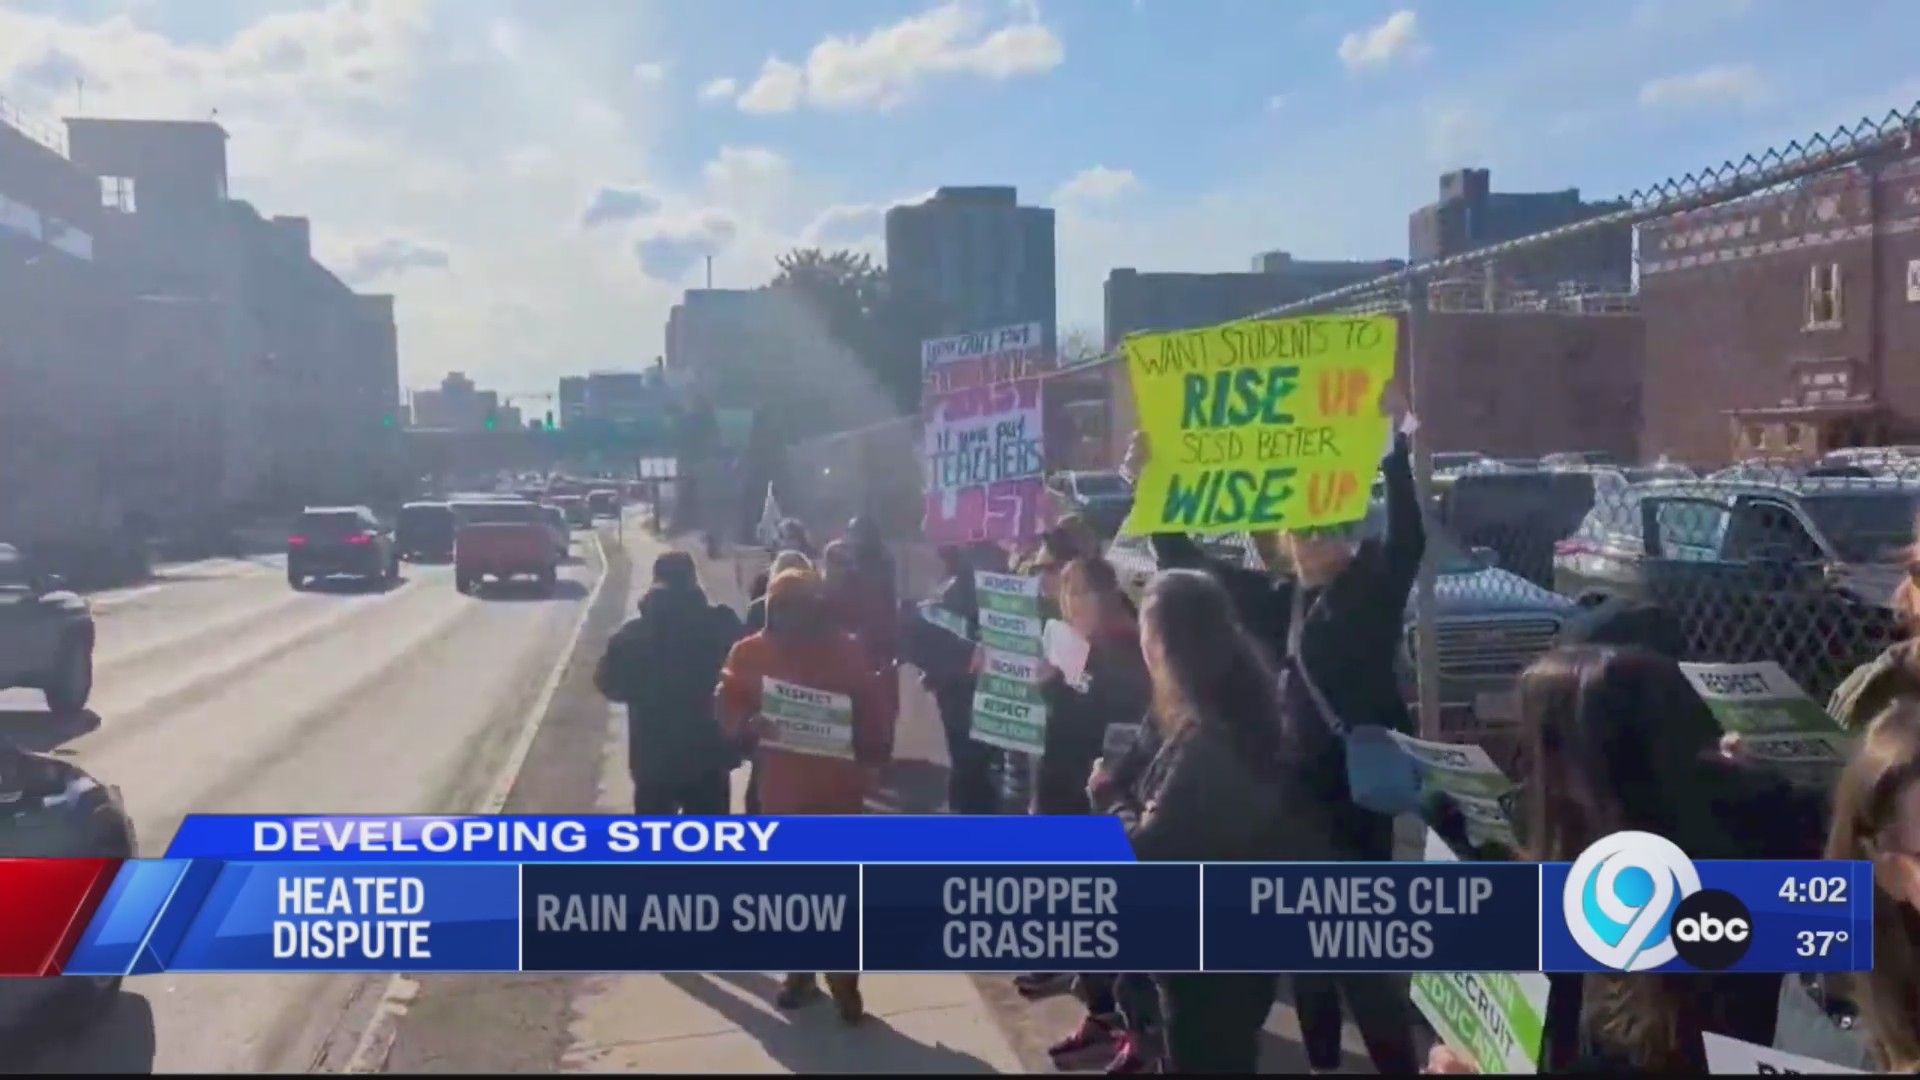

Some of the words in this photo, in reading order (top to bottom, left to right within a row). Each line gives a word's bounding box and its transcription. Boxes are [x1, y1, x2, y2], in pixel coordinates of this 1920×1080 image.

[1133, 334, 1207, 376] WANT
[1221, 321, 1328, 366] STUDENTS
[1341, 319, 1382, 351] TO
[1181, 365, 1299, 429] RISE
[1318, 367, 1370, 417] UP
[928, 439, 1043, 489] TEACHERS
[1180, 432, 1244, 464] SCSD
[1258, 427, 1341, 461] BETTER
[1161, 467, 1297, 525] WISE
[1307, 470, 1358, 519] UP
[984, 698, 1031, 718] RESPECT
